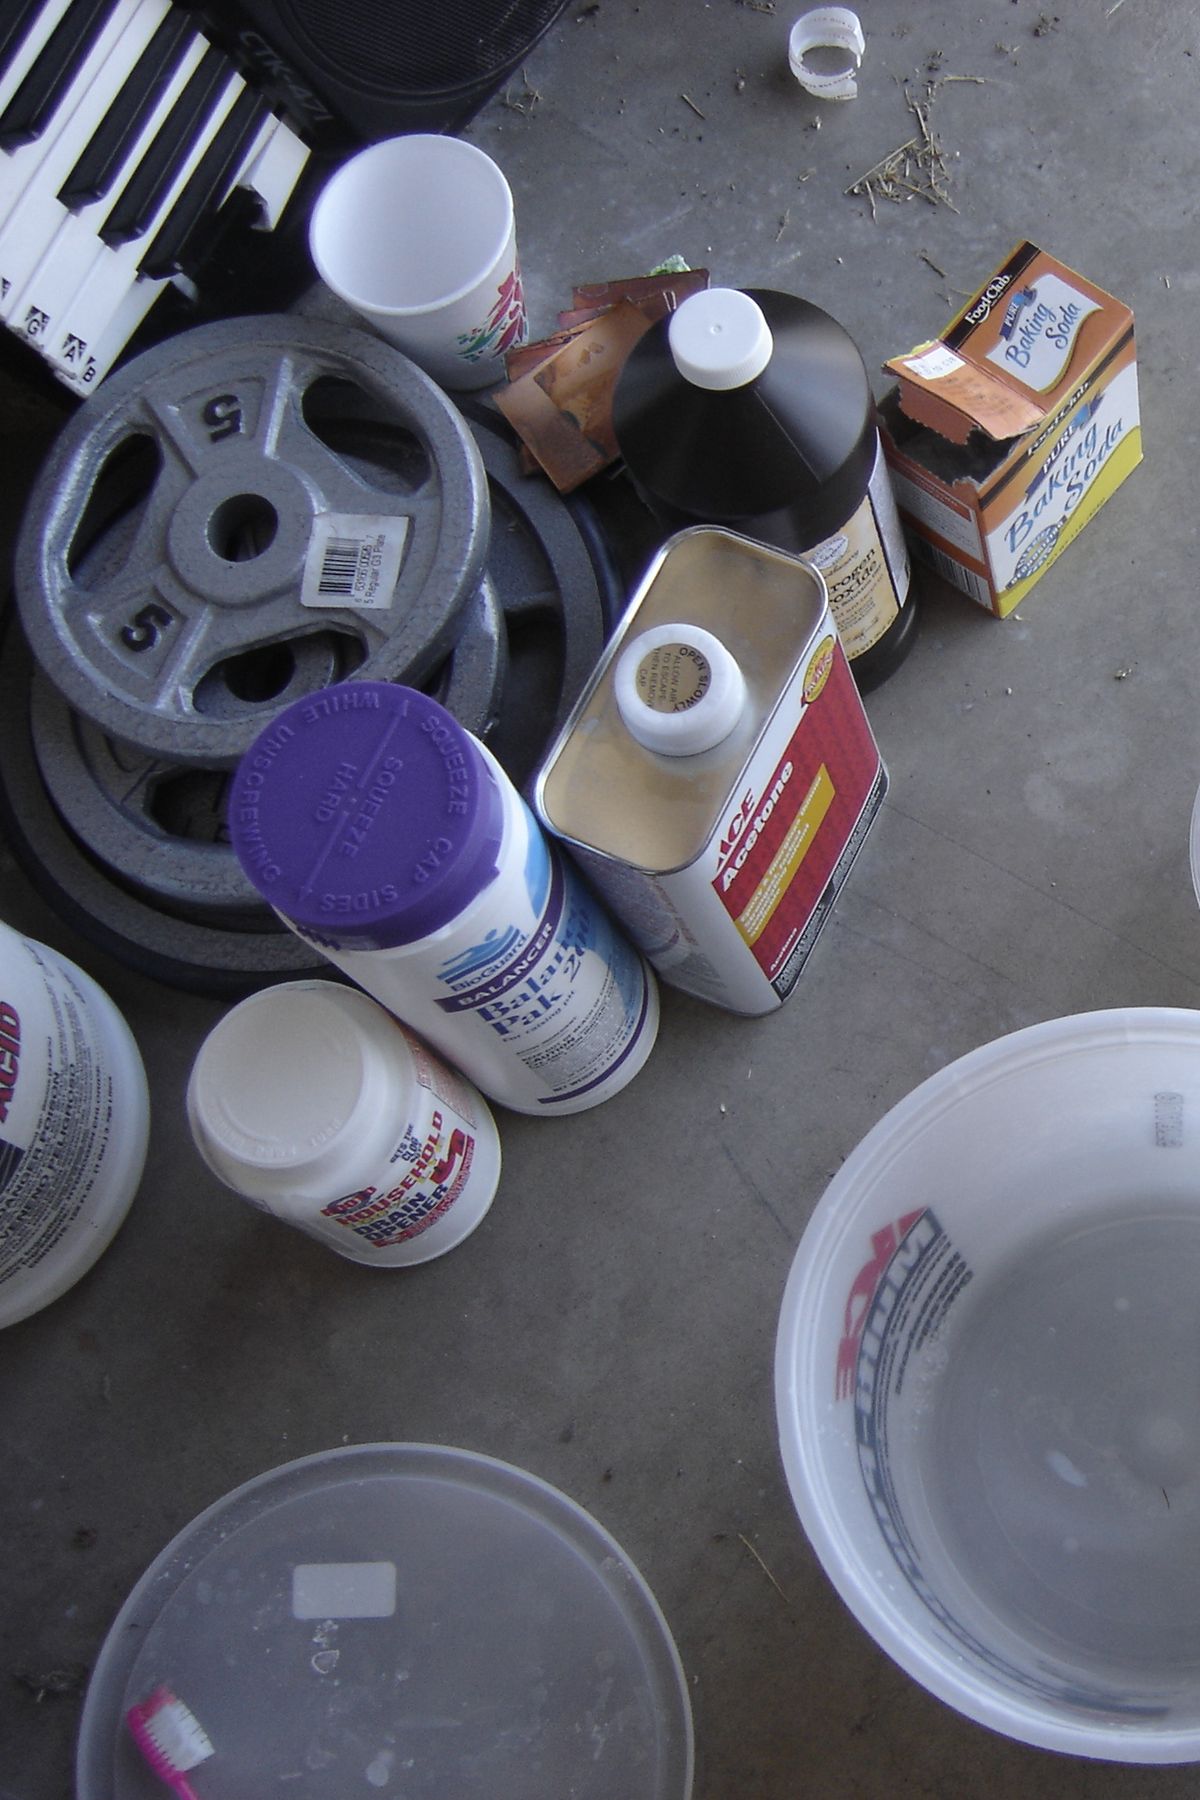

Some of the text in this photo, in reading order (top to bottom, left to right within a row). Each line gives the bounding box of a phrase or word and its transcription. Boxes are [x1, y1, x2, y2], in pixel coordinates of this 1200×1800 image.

[27, 318, 41, 336] G
[63, 345, 77, 363] A
[1005, 303, 1057, 369] Baking
[1045, 303, 1082, 350] Soda
[82, 365, 97, 383] B
[203, 394, 243, 444] 5
[1004, 422, 1098, 554] Baking
[1064, 417, 1123, 512] Soda
[829, 560, 879, 604] oxide
[830, 548, 876, 593] rogen
[120, 602, 173, 653] 5
[673, 647, 709, 712] OPEN SLOWLY
[238, 691, 380, 883] WHILE UNSCREWING
[315, 761, 359, 823] HARD
[319, 714, 470, 914] SQUEEZE CAP SIDES
[339, 755, 404, 859] SQUEEZE
[717, 788, 756, 871] ACE
[722, 761, 794, 892] Acetone
[451, 936, 528, 992] BioGuard
[458, 922, 553, 1006] BALANCER
[492, 991, 563, 1036] Pak
[335, 1110, 443, 1226] HOUSEHOLD
[352, 1191, 427, 1236] DRAIN
[364, 1183, 449, 1242] OPENER
